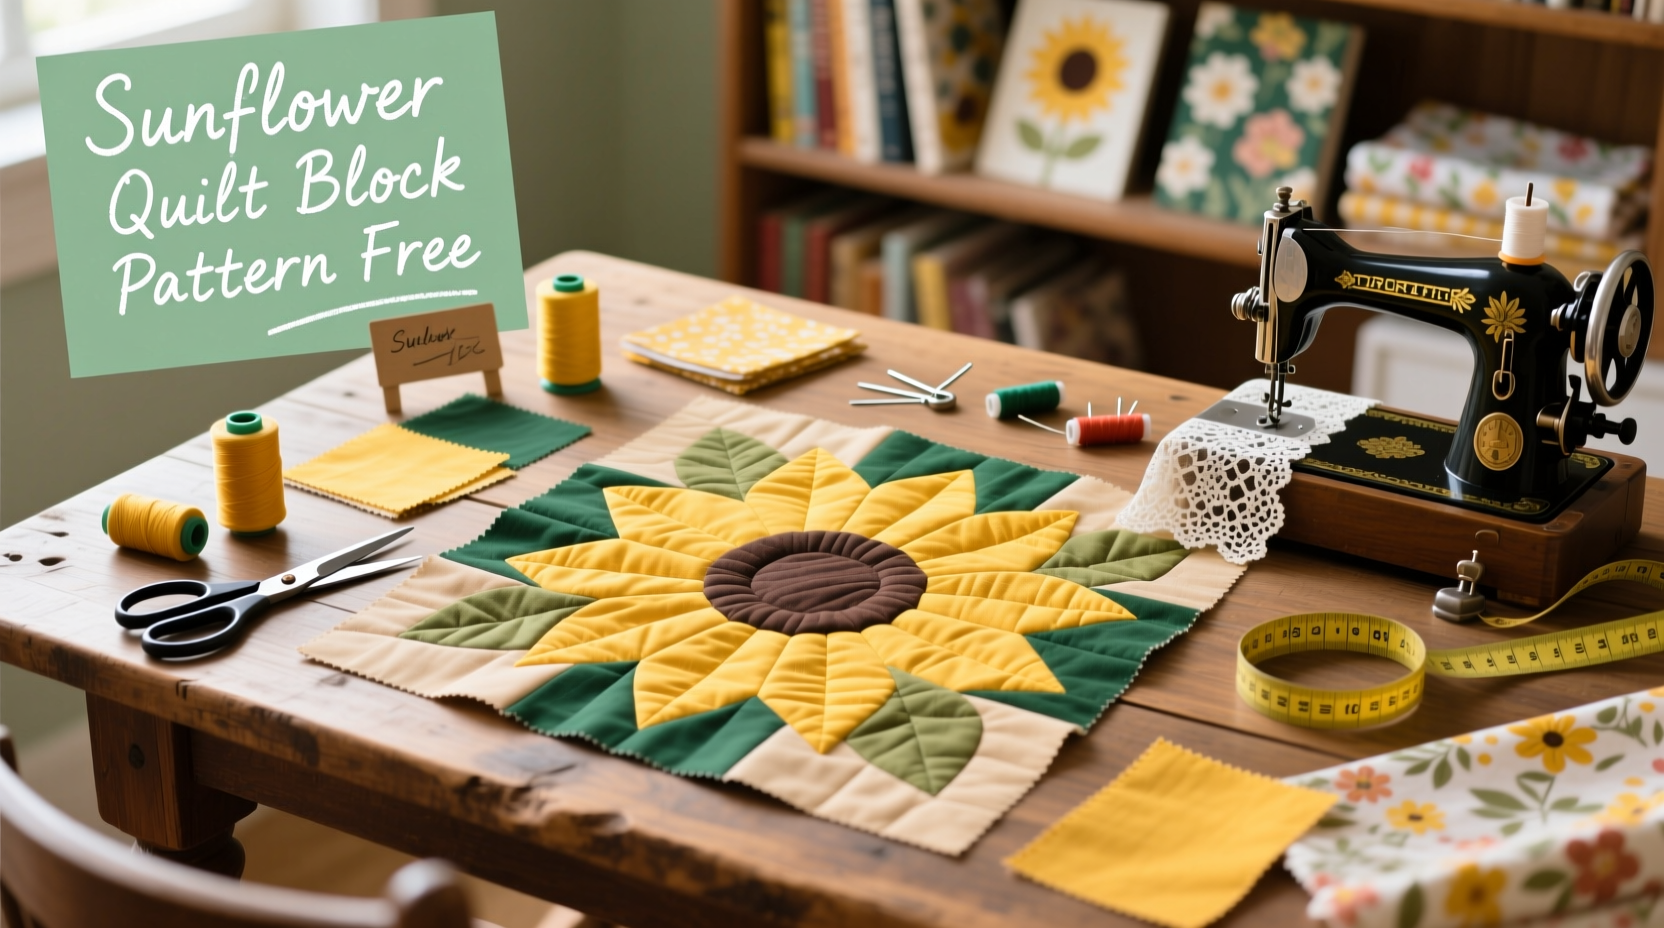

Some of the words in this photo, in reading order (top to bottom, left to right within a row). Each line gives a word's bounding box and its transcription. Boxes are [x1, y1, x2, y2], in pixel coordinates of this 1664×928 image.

[85, 61, 444, 157] Sunflower
[108, 160, 269, 240] Quilt
[295, 136, 466, 215] Block
[112, 248, 337, 316] Pattern
[360, 220, 482, 282] Free
